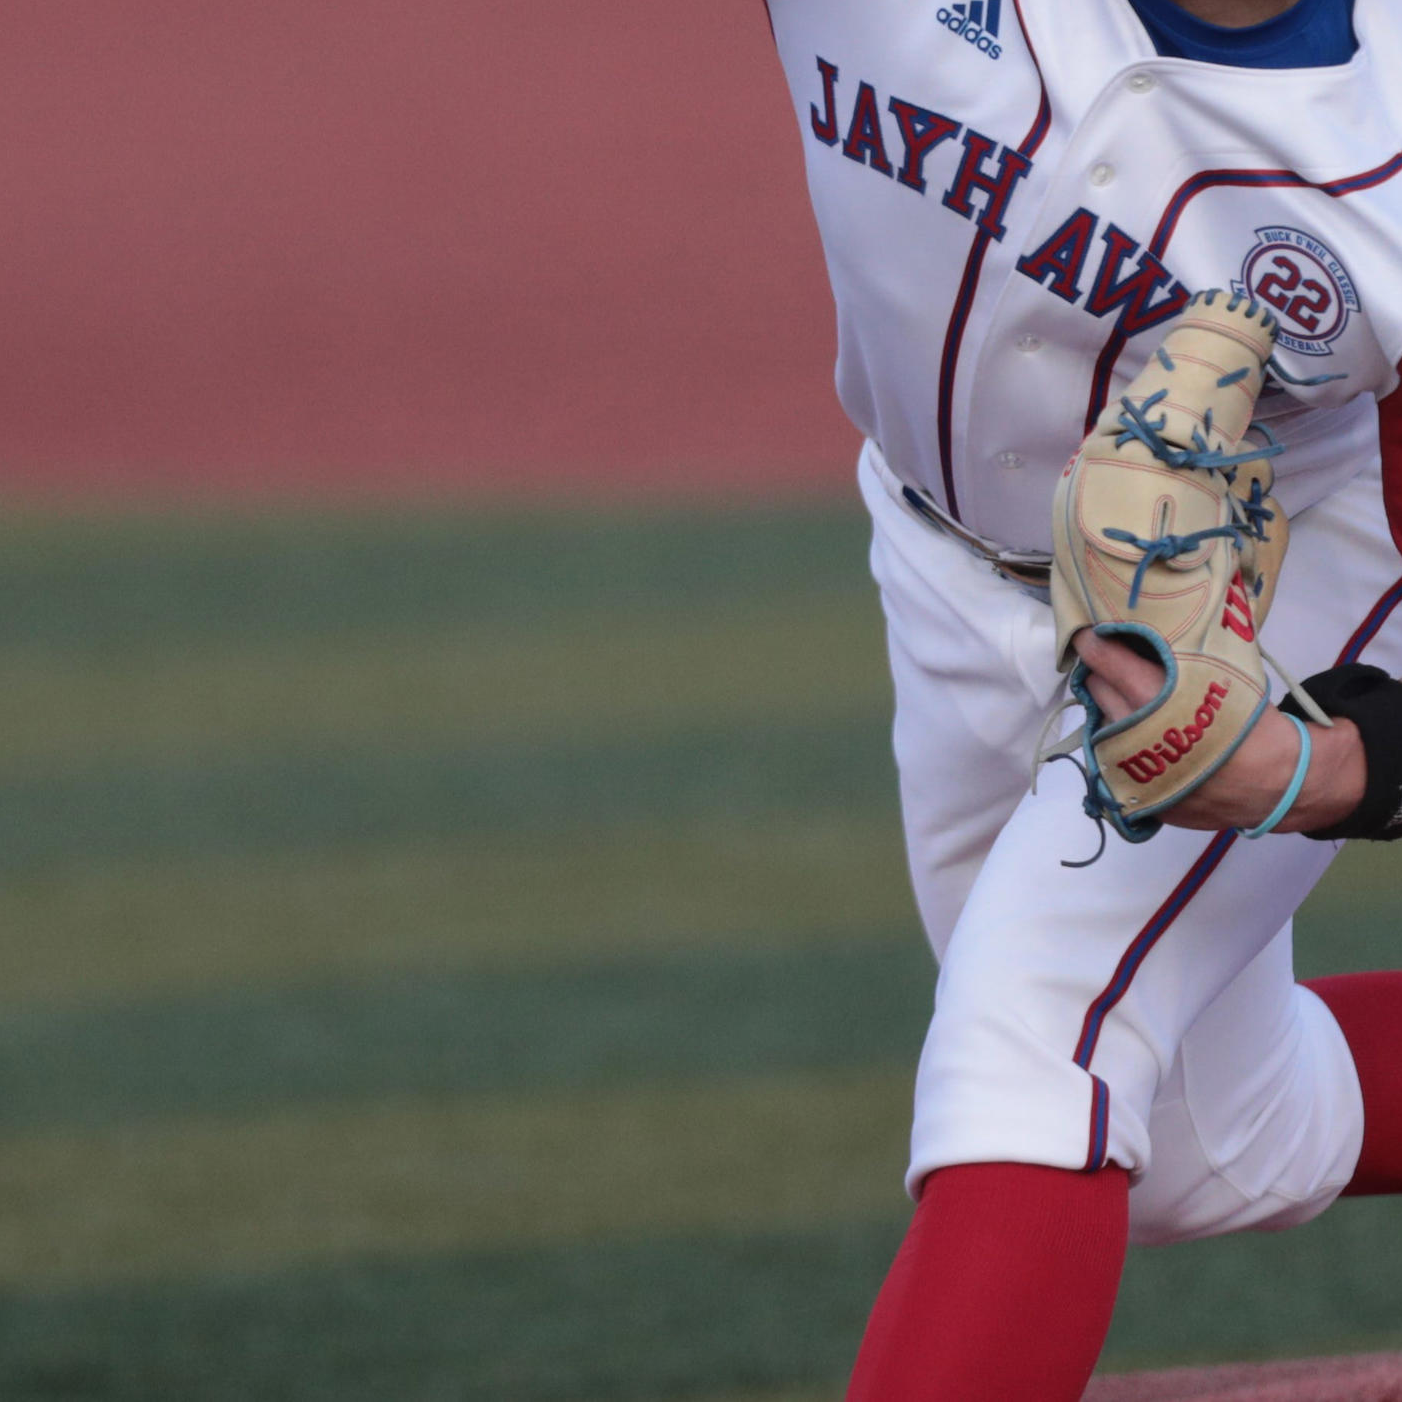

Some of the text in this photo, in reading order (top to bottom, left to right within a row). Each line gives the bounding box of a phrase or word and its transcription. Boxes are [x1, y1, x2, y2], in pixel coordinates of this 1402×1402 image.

[936, 7, 1002, 60] adidas
[810, 54, 1192, 338] JAYHAW
[1254, 255, 1332, 334] 22
[1264, 231, 1292, 243] BUCK
[1328, 261, 1356, 306] CLASSIC
[1279, 334, 1326, 352] ASEBALL
[1117, 681, 1229, 784] Wilson
